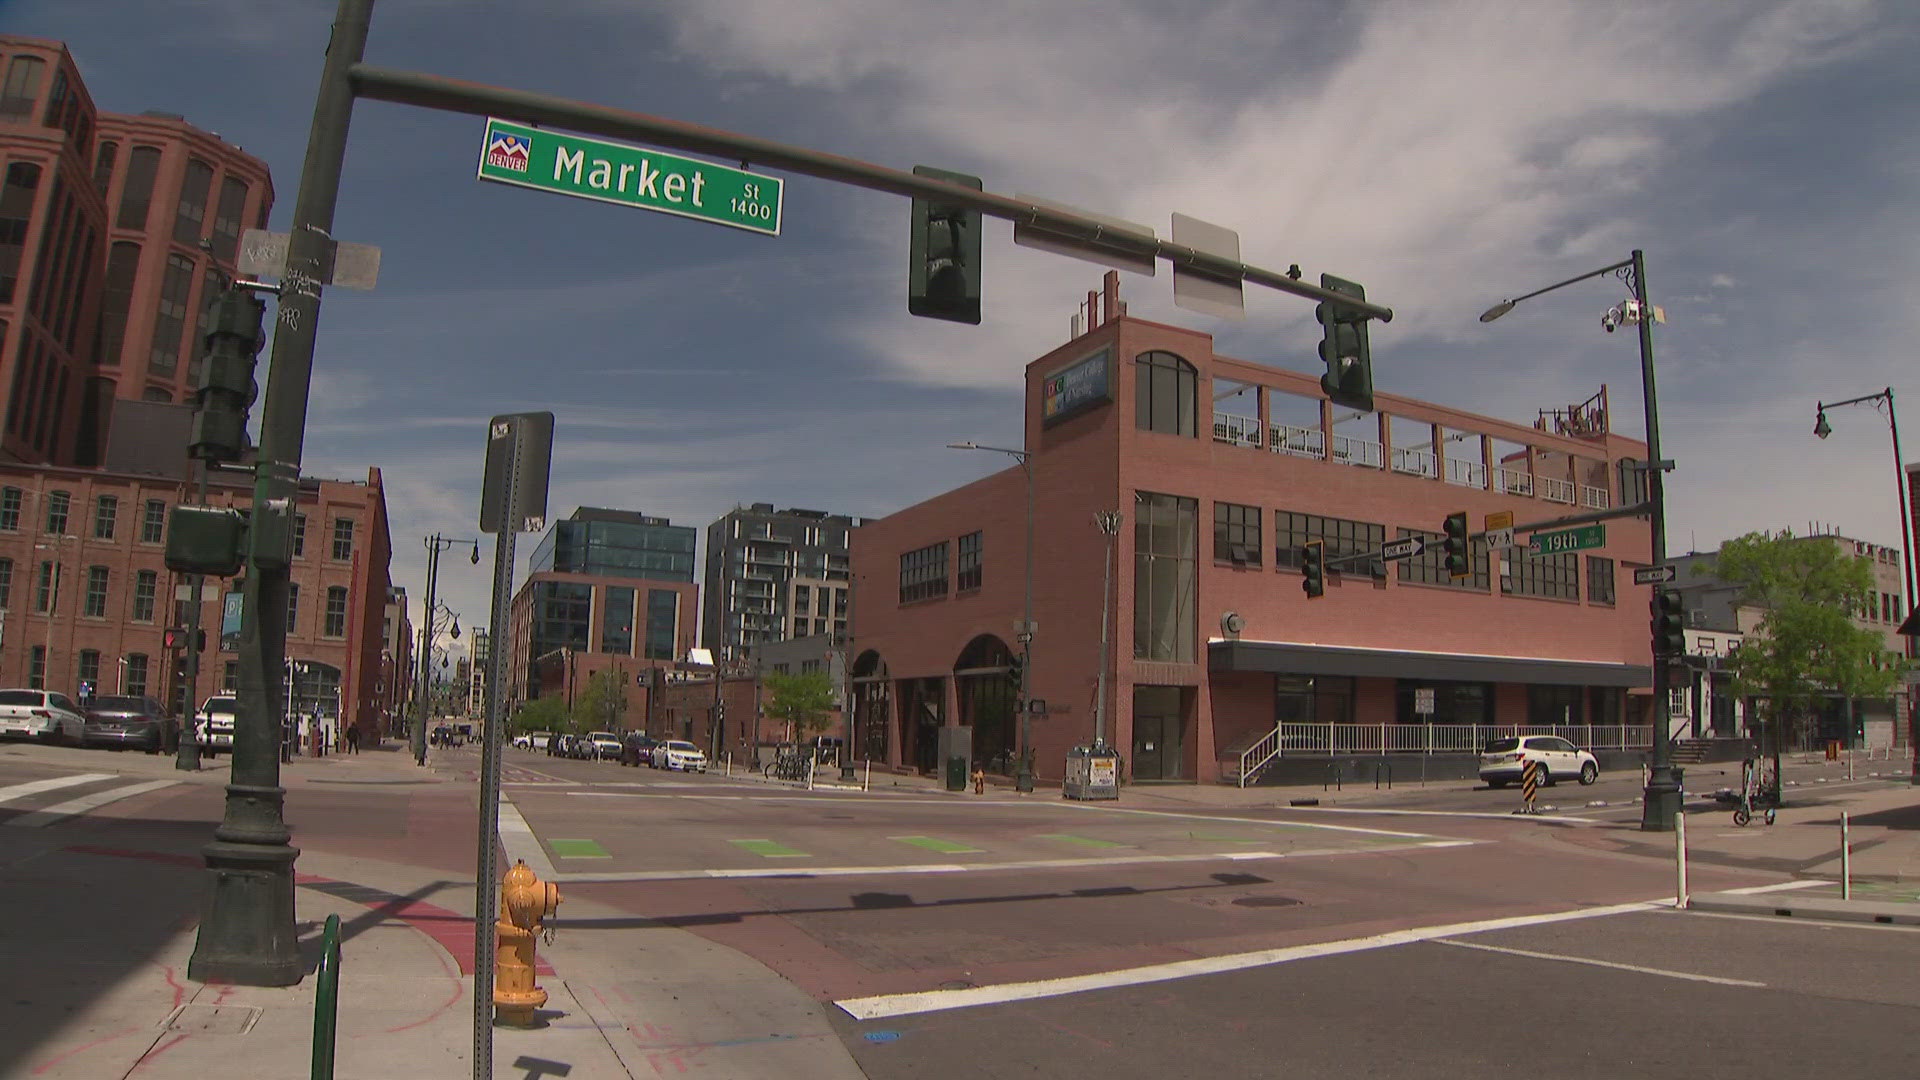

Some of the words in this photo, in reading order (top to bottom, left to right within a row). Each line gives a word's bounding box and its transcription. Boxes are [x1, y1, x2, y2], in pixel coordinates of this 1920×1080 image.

[487, 152, 527, 173] DENVER
[553, 145, 706, 208] Market
[743, 182, 761, 200] St
[729, 197, 771, 220] 1400
[1385, 545, 1398, 557] ONE
[1399, 543, 1412, 554] WAY
[1546, 532, 1578, 551] 19th
